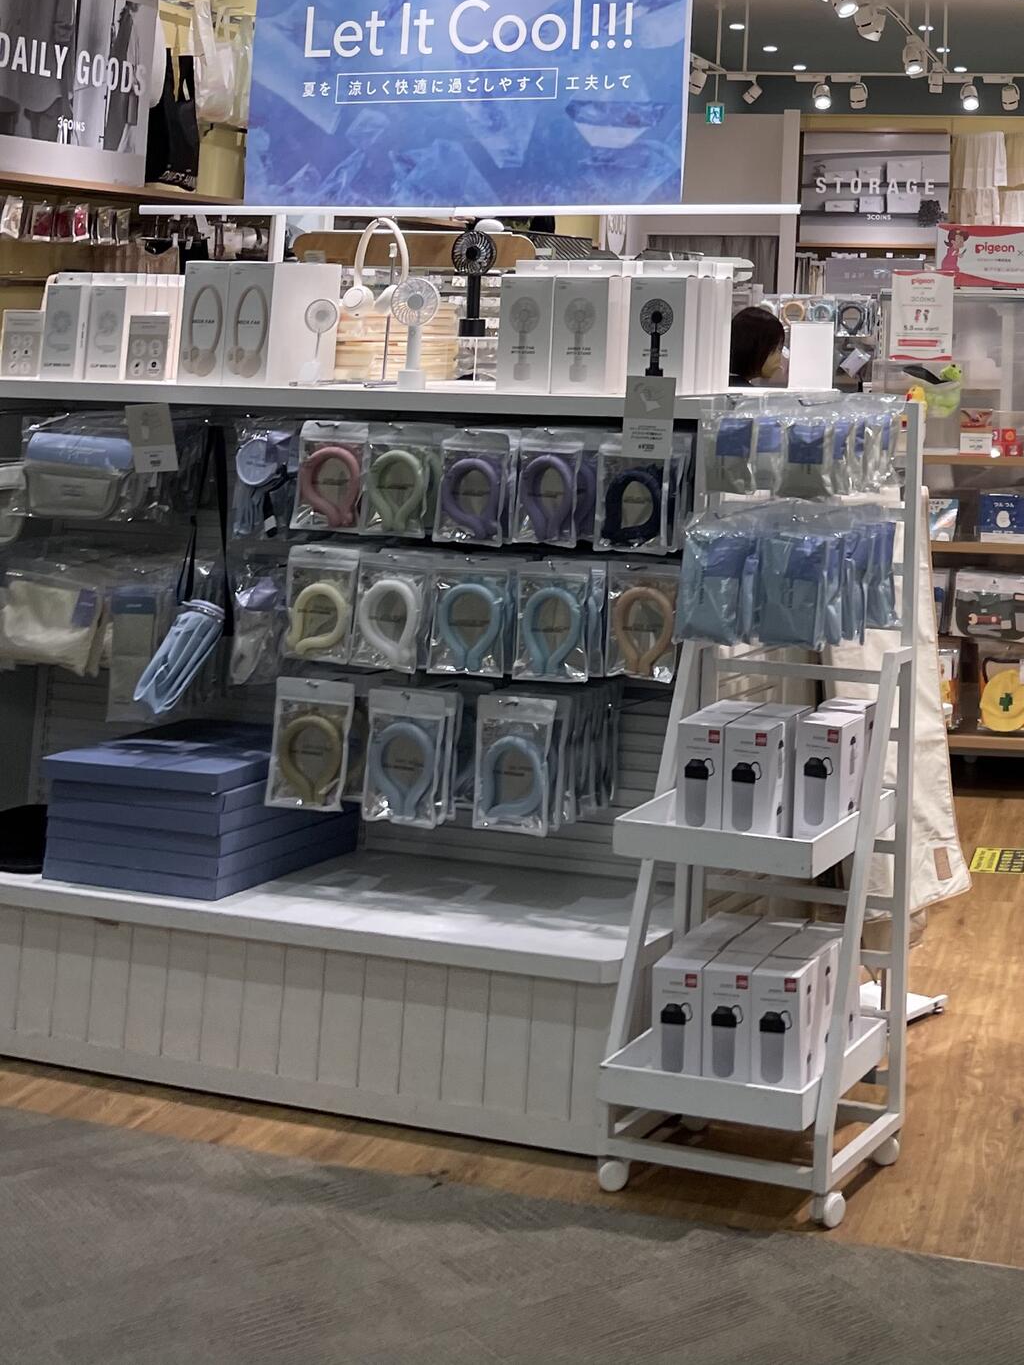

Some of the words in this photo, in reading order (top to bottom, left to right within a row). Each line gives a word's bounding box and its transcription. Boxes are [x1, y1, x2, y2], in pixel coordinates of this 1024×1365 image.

[304, 6, 385, 58] Let
[400, 2, 435, 55] It
[0, 32, 69, 80] DAILY
[76, 50, 147, 97] GOODS
[302, 81, 332, 98] 夏を
[348, 76, 545, 96] 涼しく快適に過ごしやすく
[565, 74, 632, 91] 工夫して
[815, 177, 935, 195] STORAGE
[975, 242, 1015, 255] pigeon
